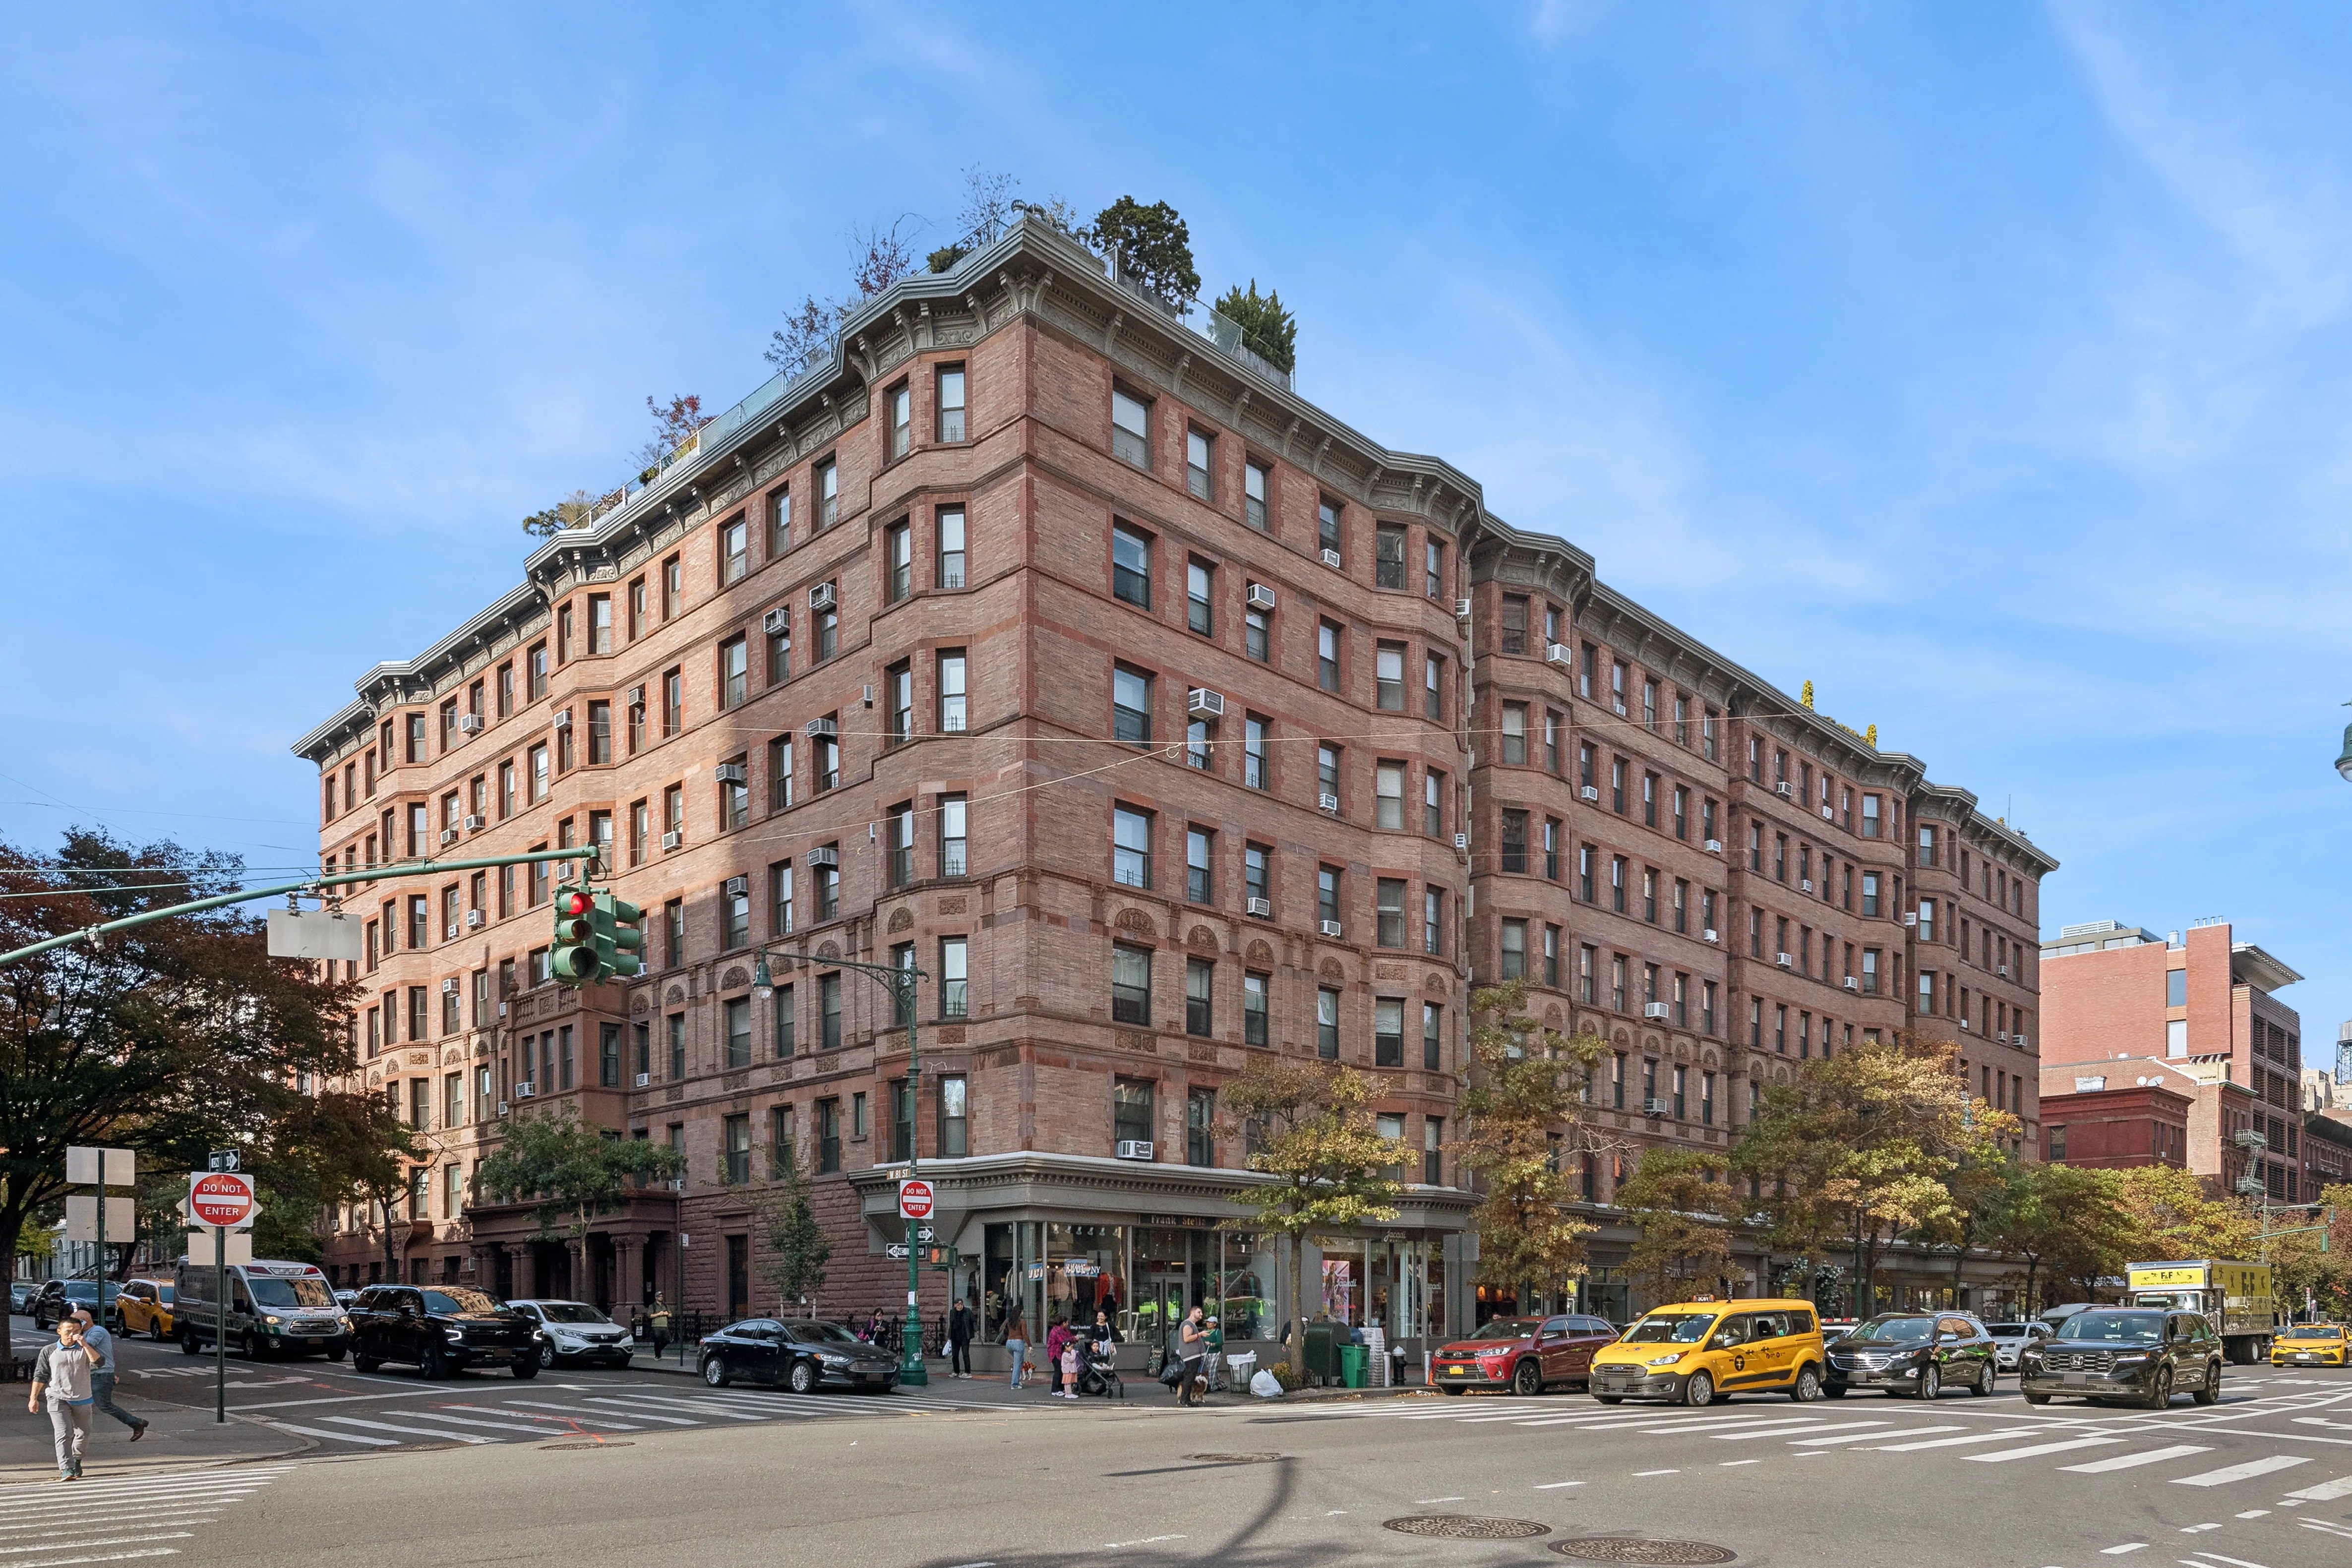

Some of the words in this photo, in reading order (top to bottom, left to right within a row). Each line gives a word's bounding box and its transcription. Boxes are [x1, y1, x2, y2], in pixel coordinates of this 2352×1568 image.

[890, 1170, 894, 1179] W
[895, 1169, 901, 1178] 81
[903, 1168, 908, 1177] ST
[203, 1184, 217, 1192] DO
[222, 1185, 241, 1193] NOT
[205, 1206, 239, 1215] ENTER
[1151, 1214, 1176, 1225] Frank
[1182, 1215, 1206, 1226] Stella
[1384, 1228, 1406, 1242] Jacadi
[1090, 1266, 1101, 1274] NY
